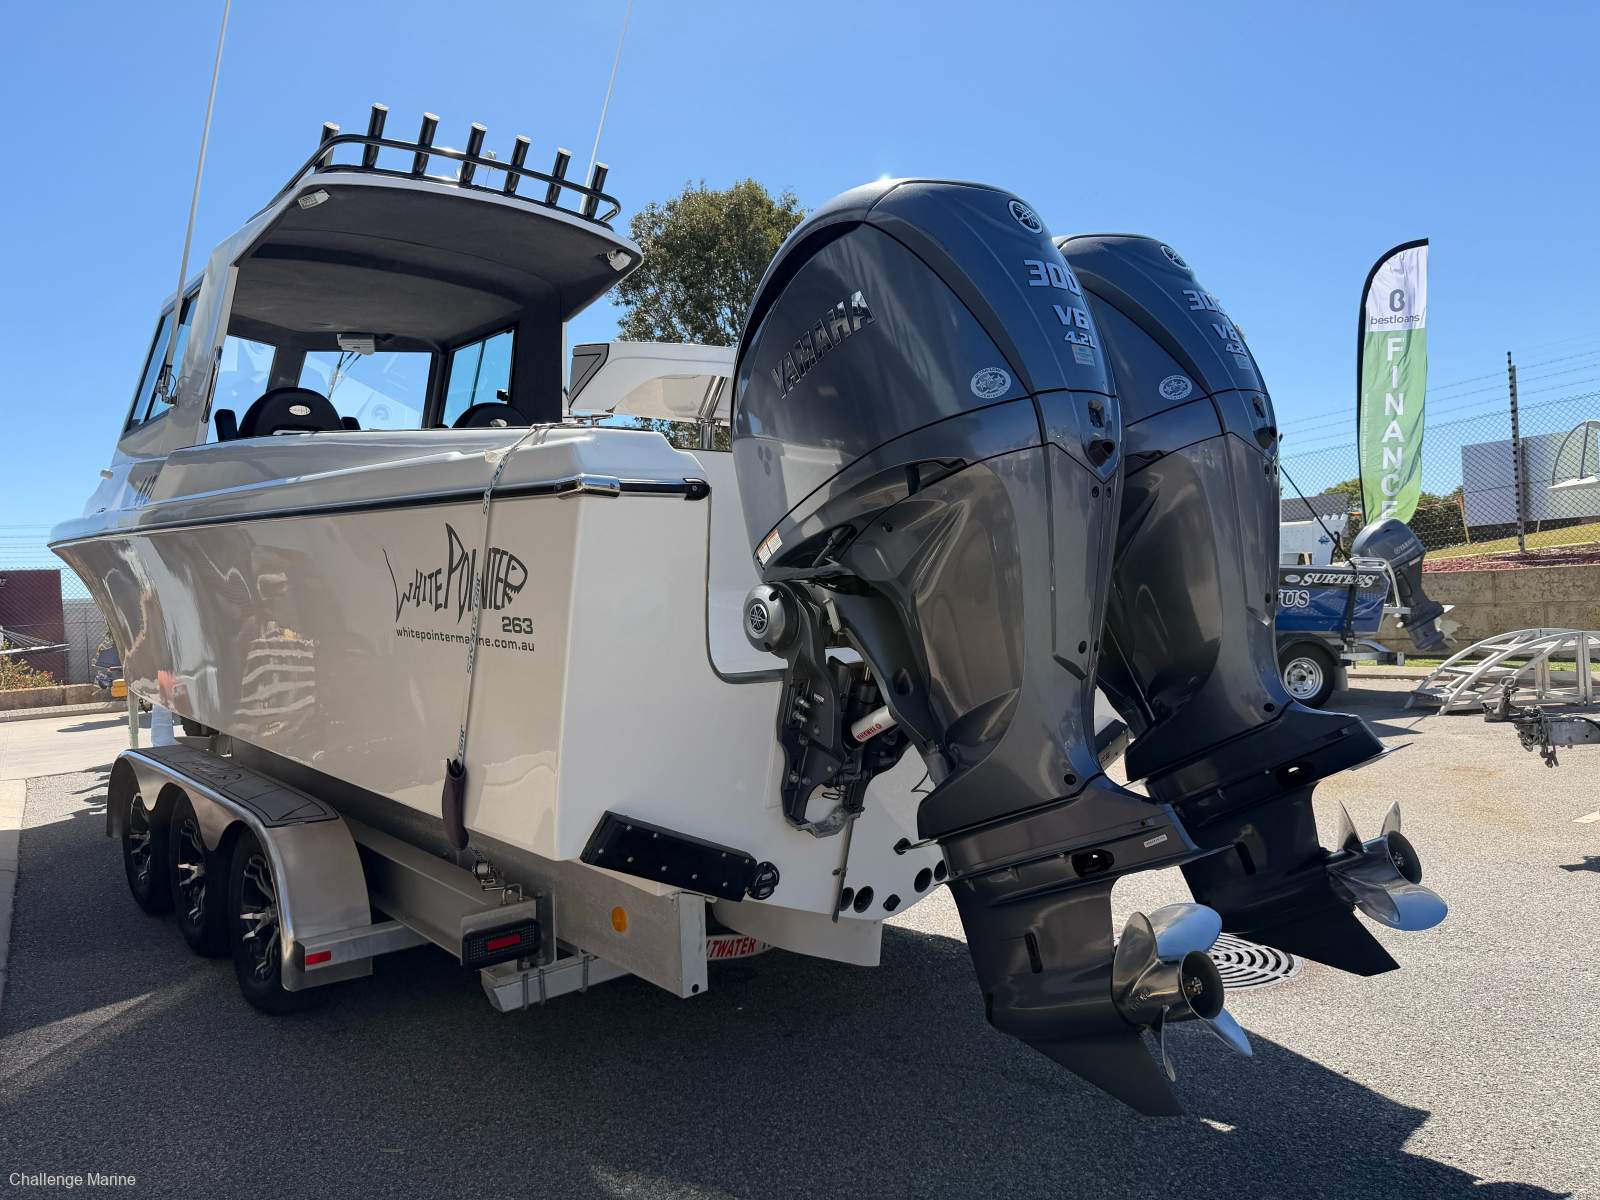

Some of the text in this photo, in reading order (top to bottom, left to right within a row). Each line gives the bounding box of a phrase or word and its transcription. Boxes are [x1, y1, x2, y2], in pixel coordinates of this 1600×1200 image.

[1023, 259, 1081, 296] 300
[1183, 289, 1226, 316] 30
[1052, 305, 1090, 330] V6
[1370, 314, 1420, 325] bestloans
[770, 290, 876, 399] YAMAHA
[1381, 337, 1405, 521] FINANCE
[382, 548, 443, 623] WHITE
[1300, 573, 1376, 588] SURTEES
[1279, 589, 1310, 608] US
[501, 616, 534, 635] 263
[395, 627, 535, 652] whitepointermaine.com.au
